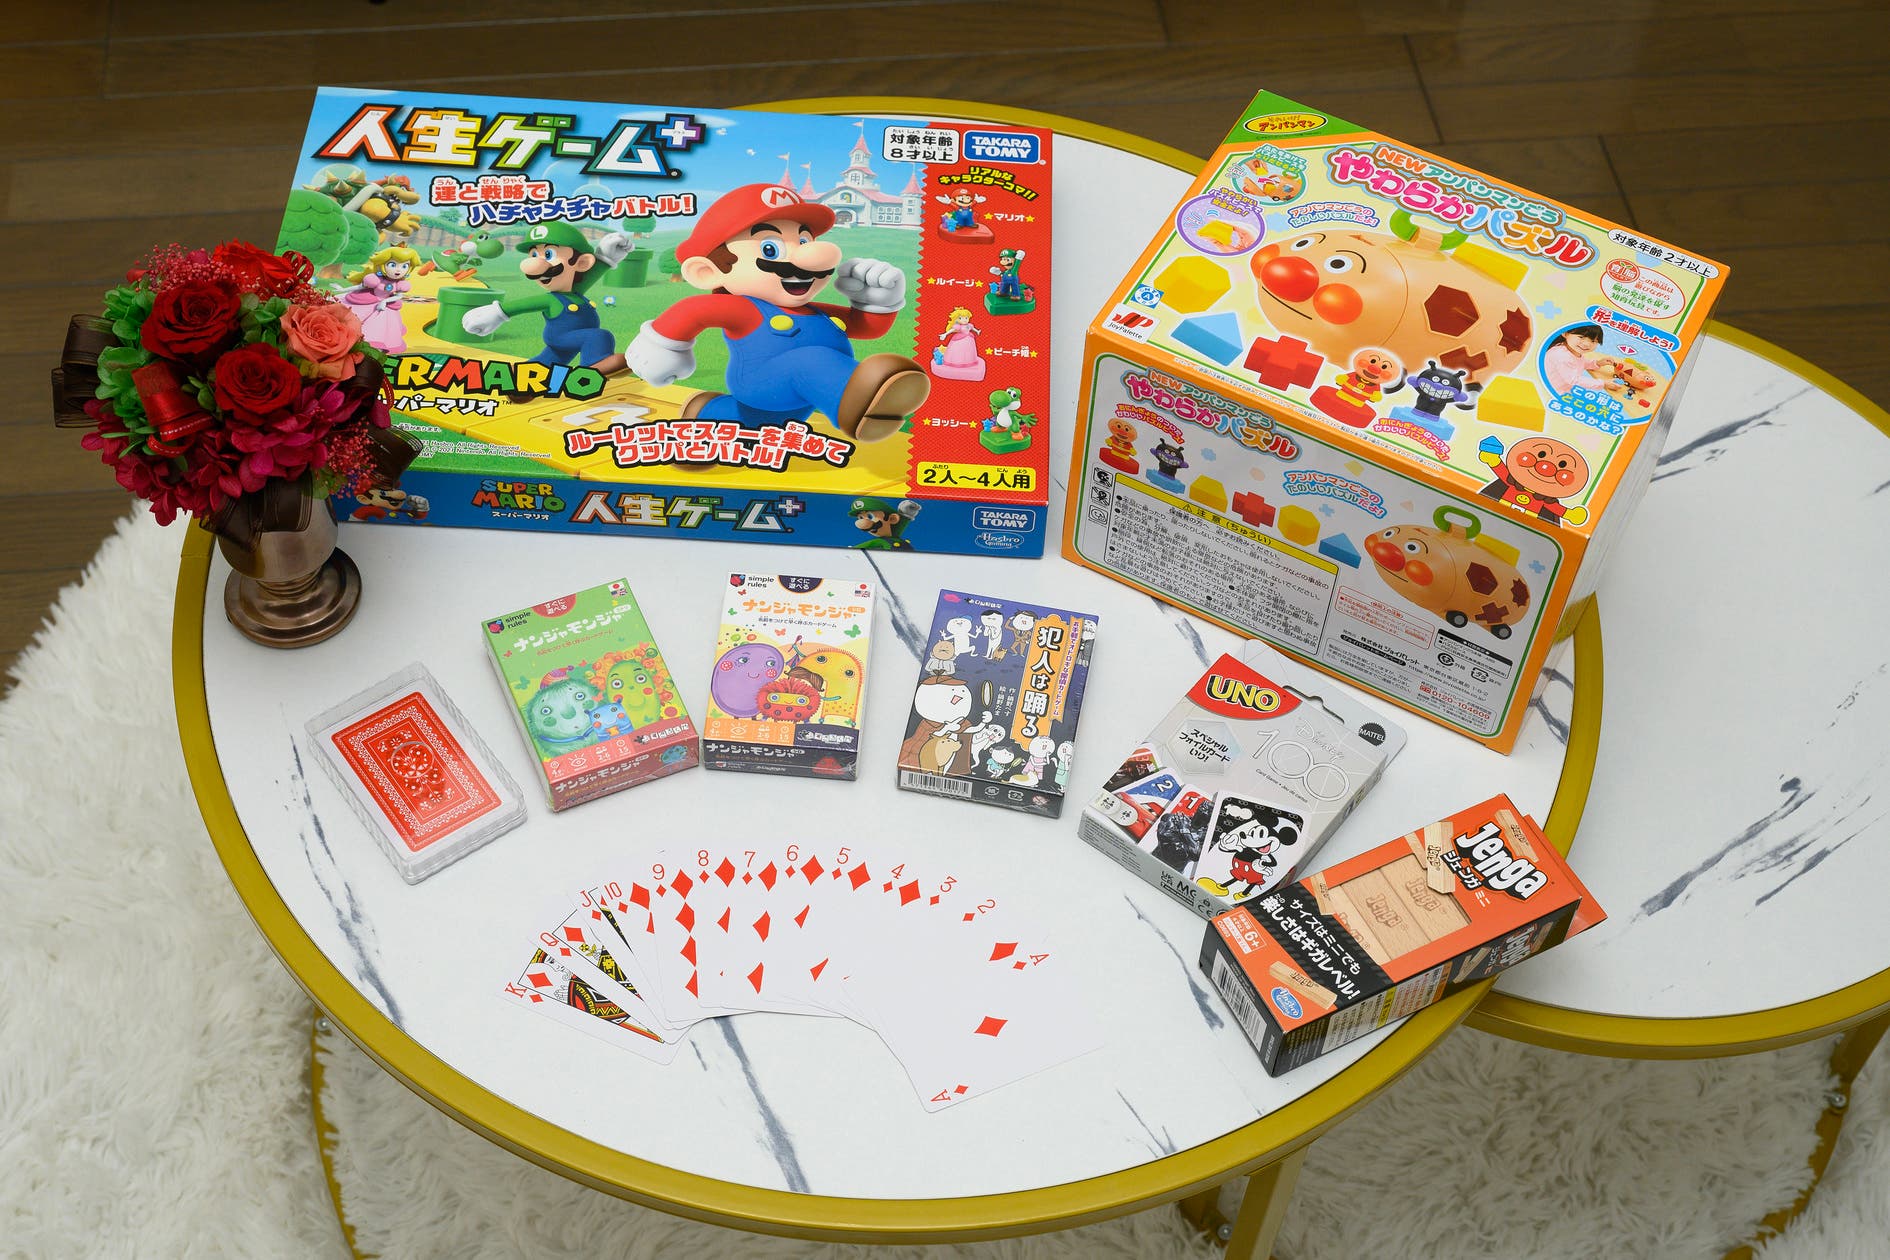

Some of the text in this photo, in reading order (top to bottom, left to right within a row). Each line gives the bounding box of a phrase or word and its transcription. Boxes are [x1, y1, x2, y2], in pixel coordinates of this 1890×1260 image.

[890, 134, 953, 146] 対象年齢
[972, 136, 1031, 148] TAKARA
[890, 148, 953, 161] 8才以上
[972, 146, 1031, 158] TOMY
[970, 166, 1013, 180] リアルな
[434, 181, 547, 201] 運と戦略で
[471, 196, 694, 224] ハチャメチャバトル!
[993, 211, 1026, 223] マリオ
[1290, 202, 1376, 219] アンパンマンごうの
[1334, 151, 1593, 266] やわらかパズル
[1612, 231, 1664, 259] 対象年齢
[935, 276, 976, 288] ルイージ
[1591, 309, 1674, 351] 形を理解しよう!
[434, 358, 605, 396] MARIO
[931, 416, 968, 428] ヨッシー
[1126, 374, 1299, 460] やわらかパズル
[569, 421, 850, 463] ルーレットでスターを集めて
[618, 441, 786, 468] クッパとバトル!
[481, 479, 553, 496] SUPER
[1287, 472, 1380, 504] アンパンマンごうの
[472, 490, 566, 512] MARIO
[492, 511, 549, 521] スーパーマリオ
[980, 510, 1028, 520] TAKARA
[980, 518, 1028, 528] TOMY
[980, 532, 1020, 543] Hasbro
[747, 581, 767, 589] rules
[748, 576, 775, 584] simple
[505, 610, 531, 623] simple
[742, 599, 855, 620] ナンジャモンジャ
[507, 618, 528, 630] rules
[513, 610, 624, 652] ナンジャモンジャ
[1020, 626, 1065, 738] 犯人は踊る
[1206, 674, 1281, 712] UNO
[1190, 728, 1230, 753] スペシャル
[1359, 728, 1386, 742] MATTEL
[705, 743, 796, 758] ナンジャモンジャ
[1178, 732, 1231, 763] フォイルカード
[1251, 729, 1350, 802] 100
[554, 758, 641, 794] ナンジャモンジャ
[1157, 780, 1174, 793] 2
[1185, 796, 1200, 810] 1
[697, 850, 710, 866] 8
[744, 851, 756, 867] 7
[786, 844, 799, 861] 6
[836, 847, 851, 864] 5
[1456, 822, 1548, 899] Jenga
[652, 863, 665, 880] 9
[891, 863, 905, 880] 4
[1442, 850, 1481, 890] ジェンガ
[604, 882, 622, 900] 10
[940, 876, 957, 893] 3
[580, 890, 592, 908] J
[976, 898, 996, 914] 2
[540, 931, 559, 947] Q
[1244, 930, 1260, 948] 6+
[1290, 898, 1361, 976] サイズはミニでも
[1260, 895, 1362, 999] 楽しさはギガレベル!
[1029, 953, 1050, 967] A
[504, 981, 527, 998] K
[930, 1088, 951, 1102] A
